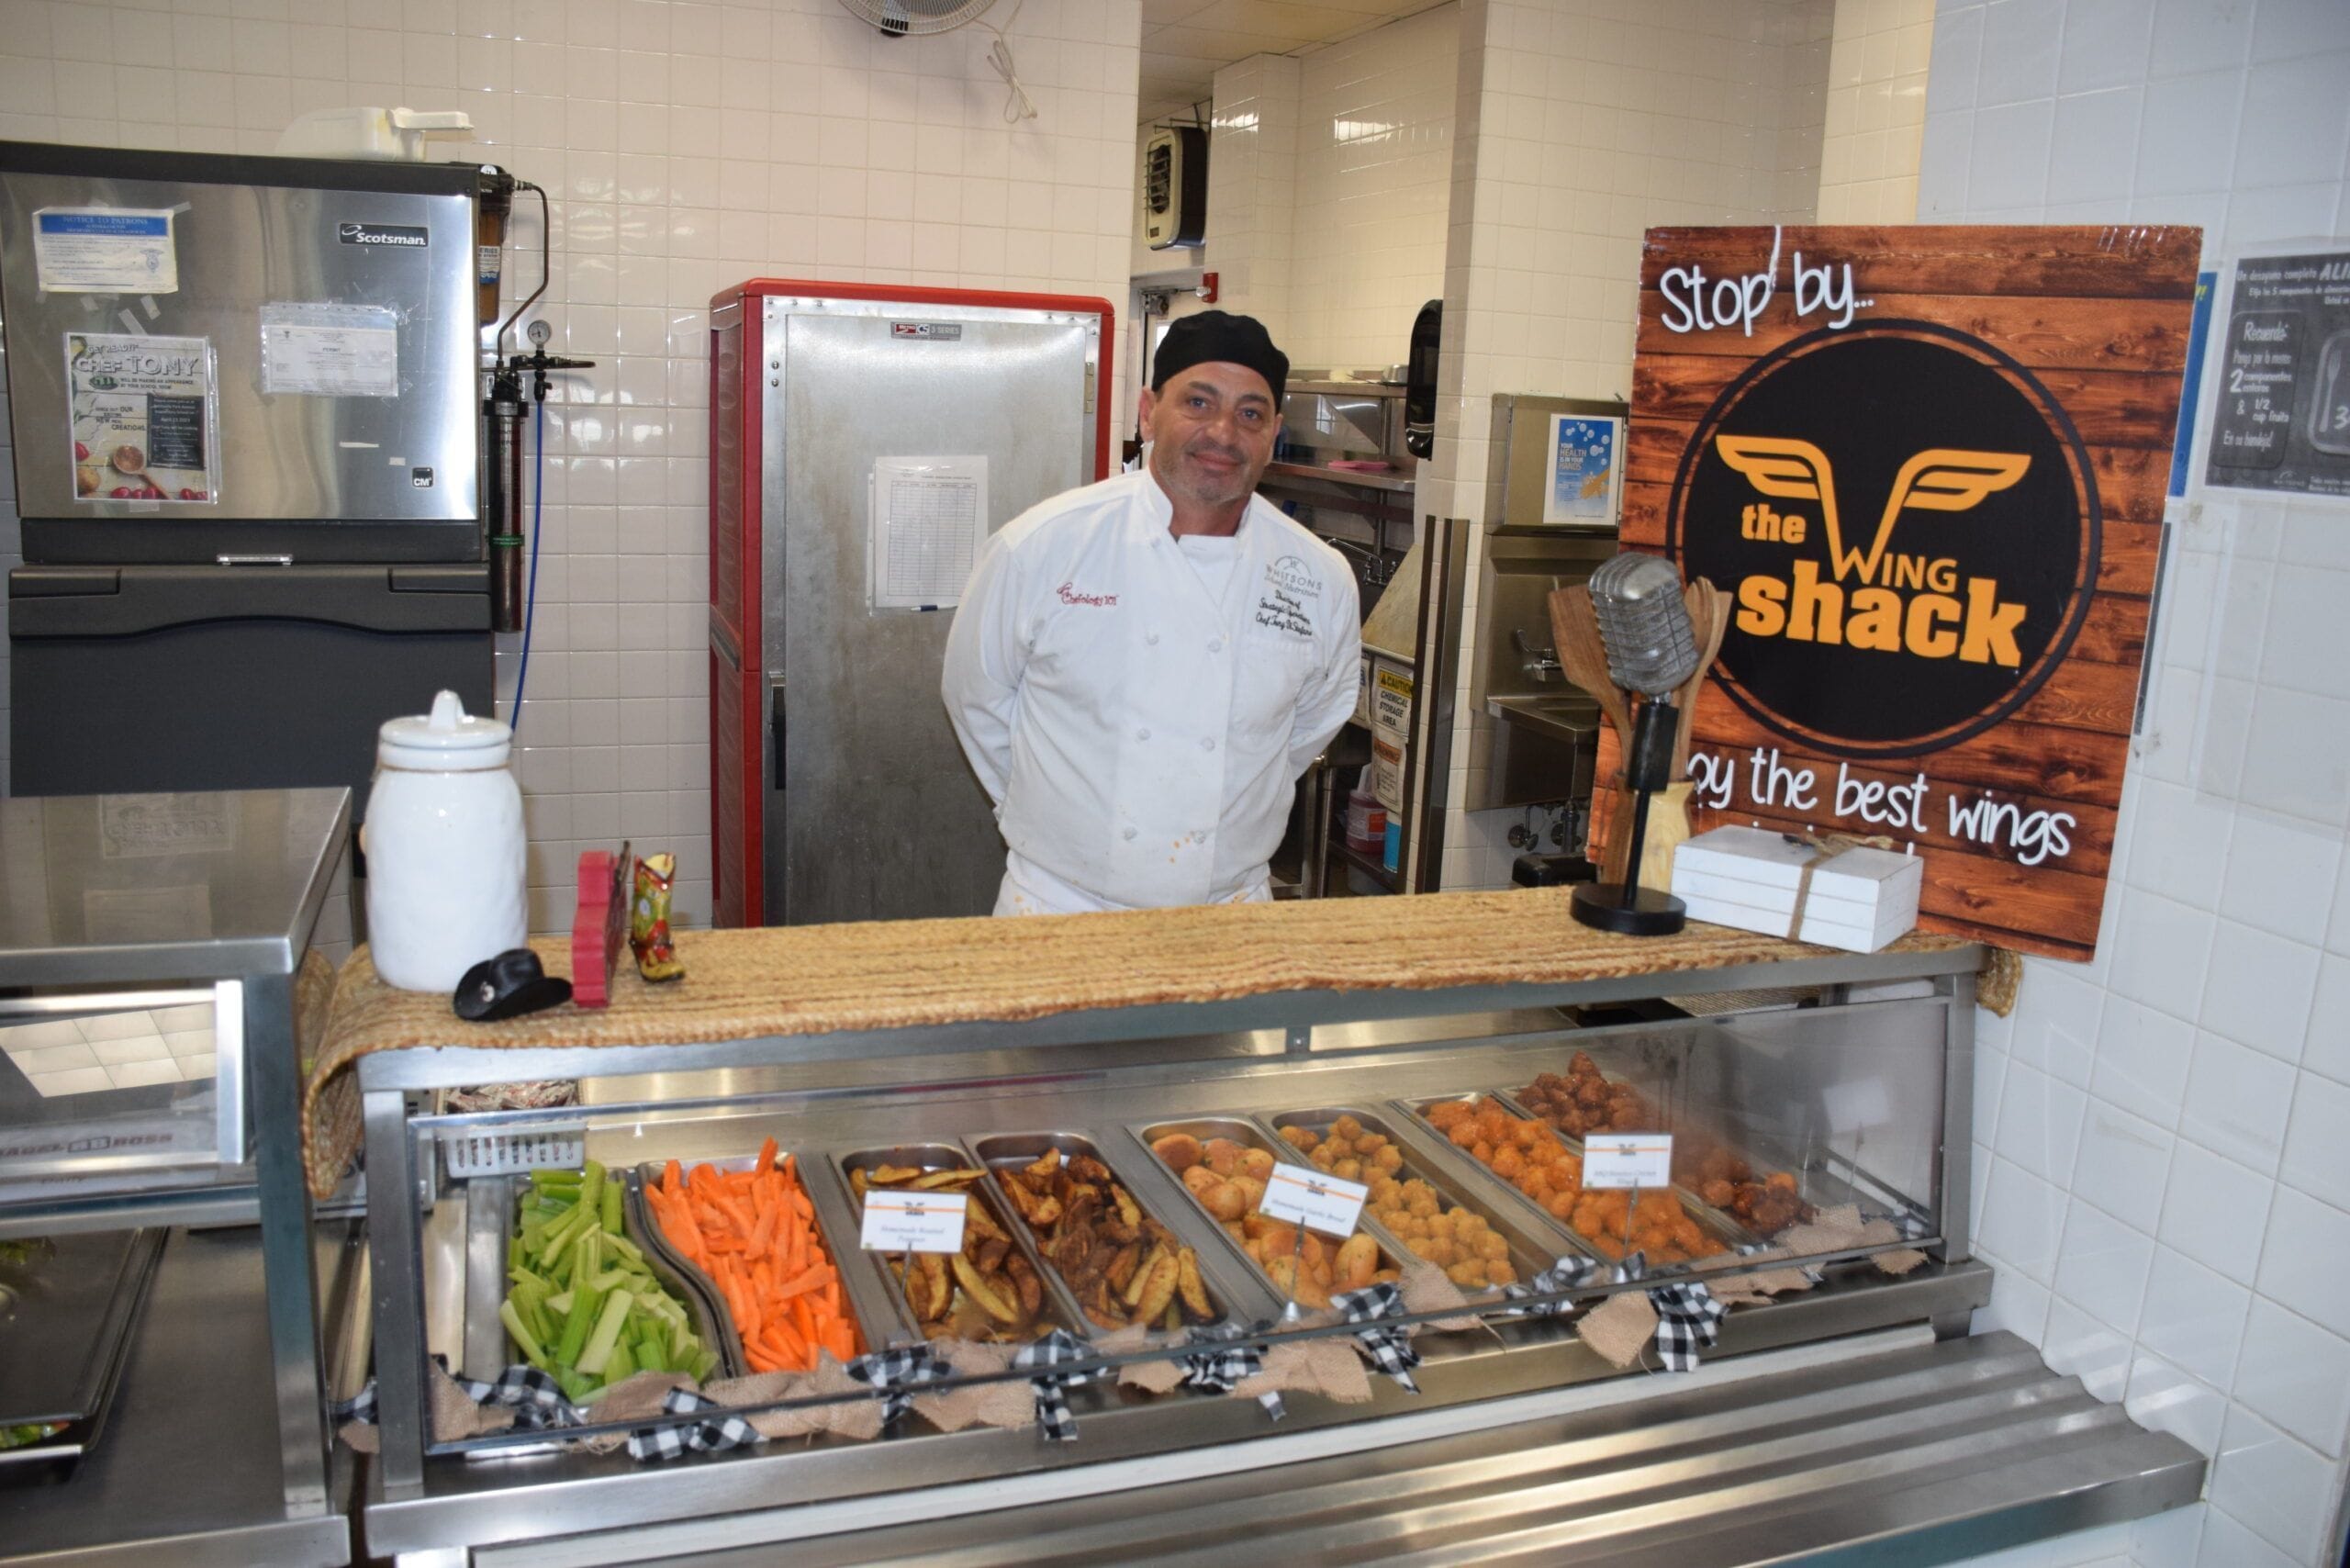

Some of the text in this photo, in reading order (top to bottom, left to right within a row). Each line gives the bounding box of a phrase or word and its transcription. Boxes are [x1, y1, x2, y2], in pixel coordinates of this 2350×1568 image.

[1660, 251, 1874, 337] Stop by...
[76, 355, 199, 376] CHEF TONY
[2230, 368, 2244, 393] 2
[1561, 448, 1586, 457] HEALTH
[1740, 503, 1807, 544] the
[1266, 564, 1322, 590] WHITSONS
[1736, 558, 2026, 668] shack
[1386, 676, 1413, 695] CAUTIO
[1379, 701, 1404, 719] STORAGE
[1380, 689, 1408, 709] CHEMICAL
[1382, 714, 1397, 727] AREA
[1750, 747, 1818, 811] the
[1835, 762, 1930, 833] best
[1949, 790, 2076, 865] wings
